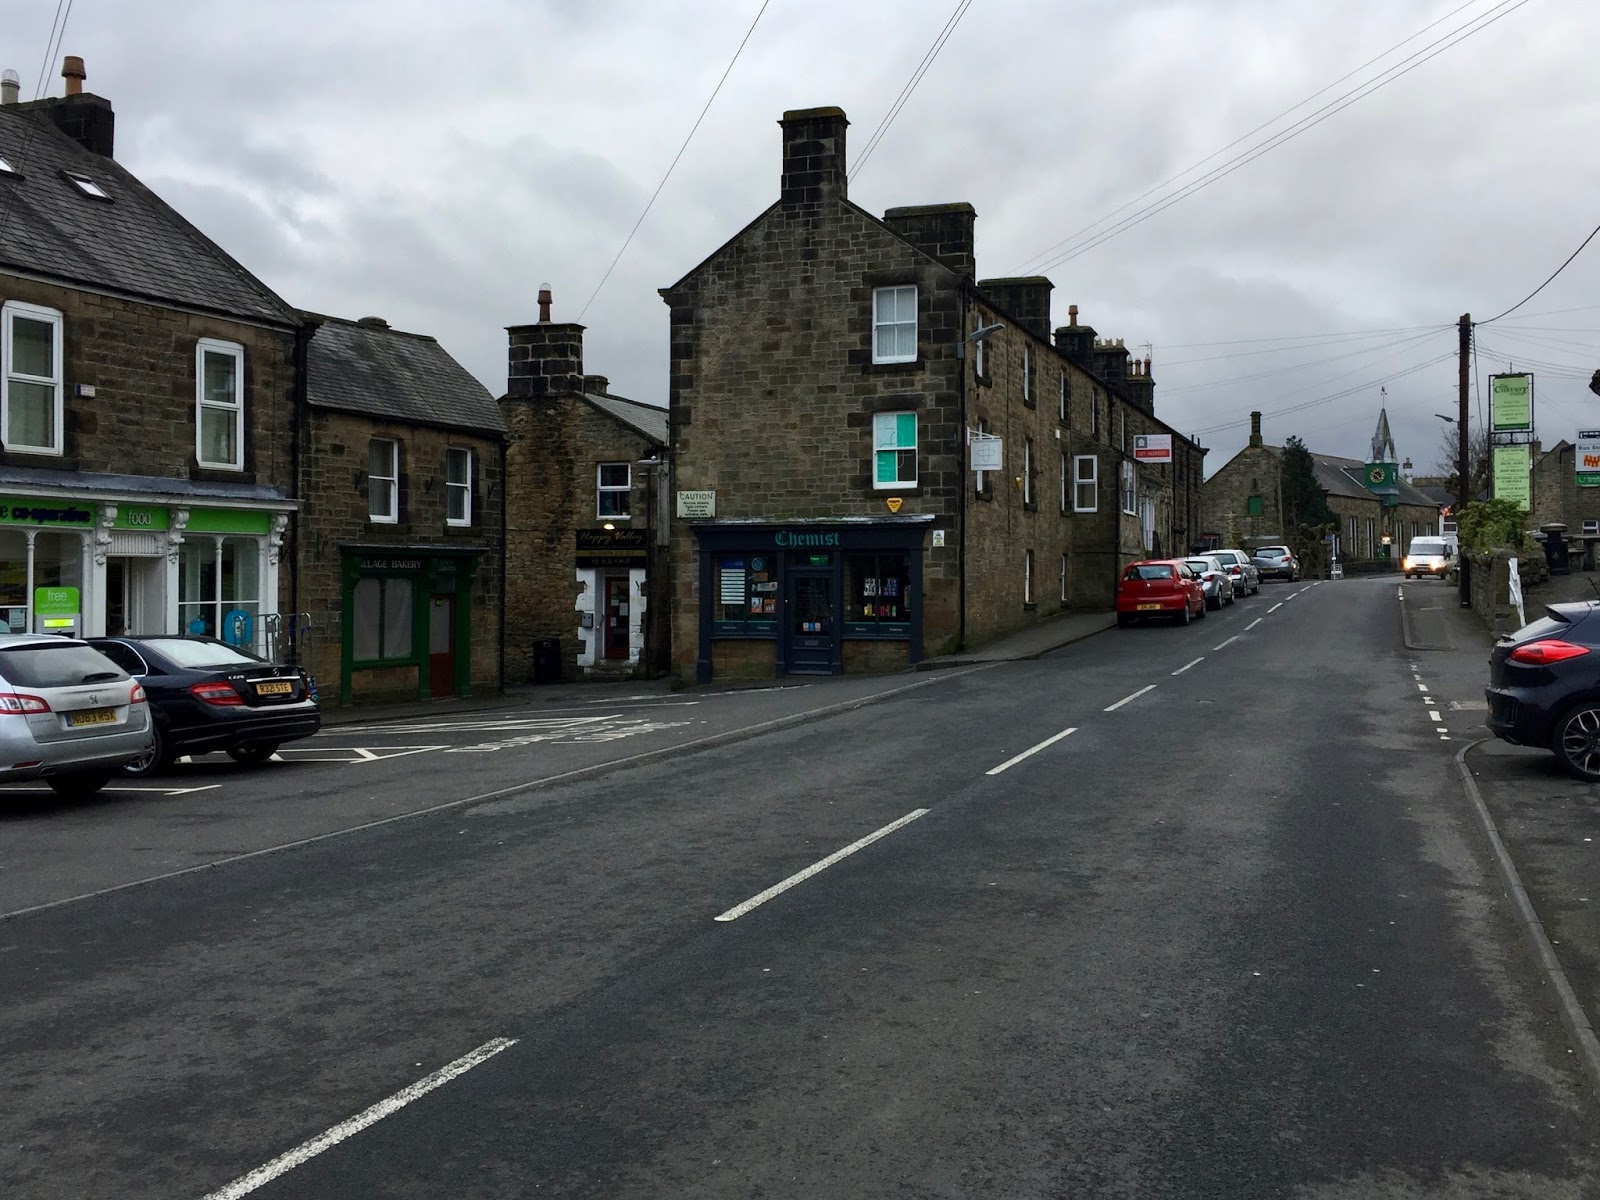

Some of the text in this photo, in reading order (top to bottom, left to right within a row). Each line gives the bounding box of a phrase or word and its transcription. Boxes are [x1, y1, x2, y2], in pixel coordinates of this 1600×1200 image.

[680, 492, 713, 500] CAUTION
[775, 530, 840, 548] Chemist
[391, 560, 421, 569] BAKERY
[47, 589, 67, 602] free
[276, 683, 289, 692] STE
[72, 709, 116, 725] NU63 RSX
